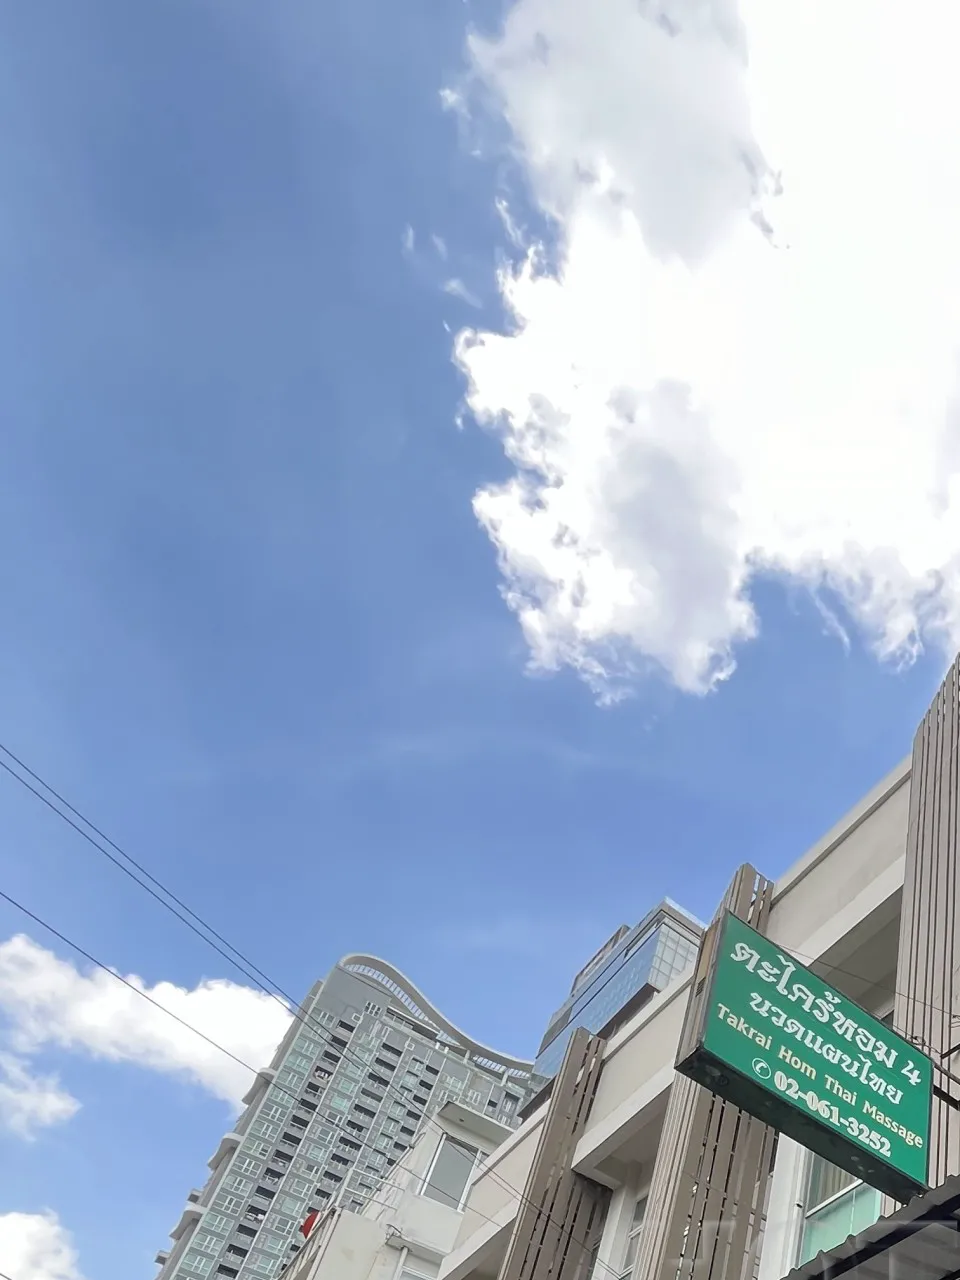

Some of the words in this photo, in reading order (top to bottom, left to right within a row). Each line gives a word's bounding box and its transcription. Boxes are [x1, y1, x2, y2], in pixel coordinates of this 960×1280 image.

[717, 1003, 773, 1050] Takrai
[777, 1046, 817, 1080] Hom
[824, 1074, 857, 1106] Thai
[862, 1100, 923, 1148] Massage
[730, 943, 898, 1069] ตะไคร้หอม
[901, 1060, 922, 1086] 4
[749, 993, 904, 1105] นวดแผนไทย
[774, 1071, 891, 1157] 02-061-3252
